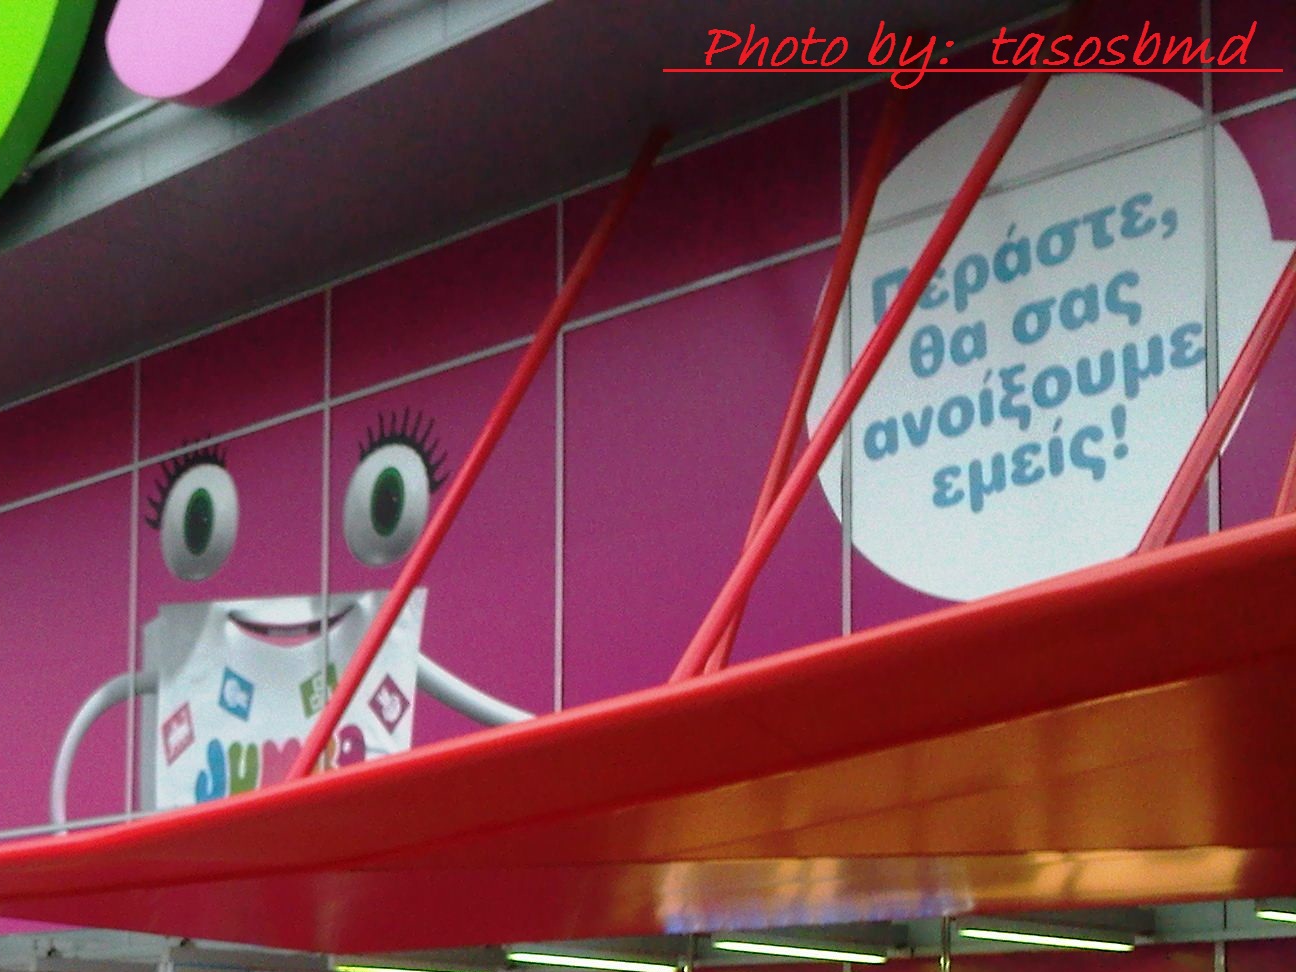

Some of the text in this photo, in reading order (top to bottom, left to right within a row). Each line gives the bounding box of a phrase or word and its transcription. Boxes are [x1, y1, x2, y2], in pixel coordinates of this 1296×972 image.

[909, 269, 1142, 379] θα σας
[862, 320, 1207, 462] ανοίξουμε
[931, 403, 1130, 514] εμείς!
